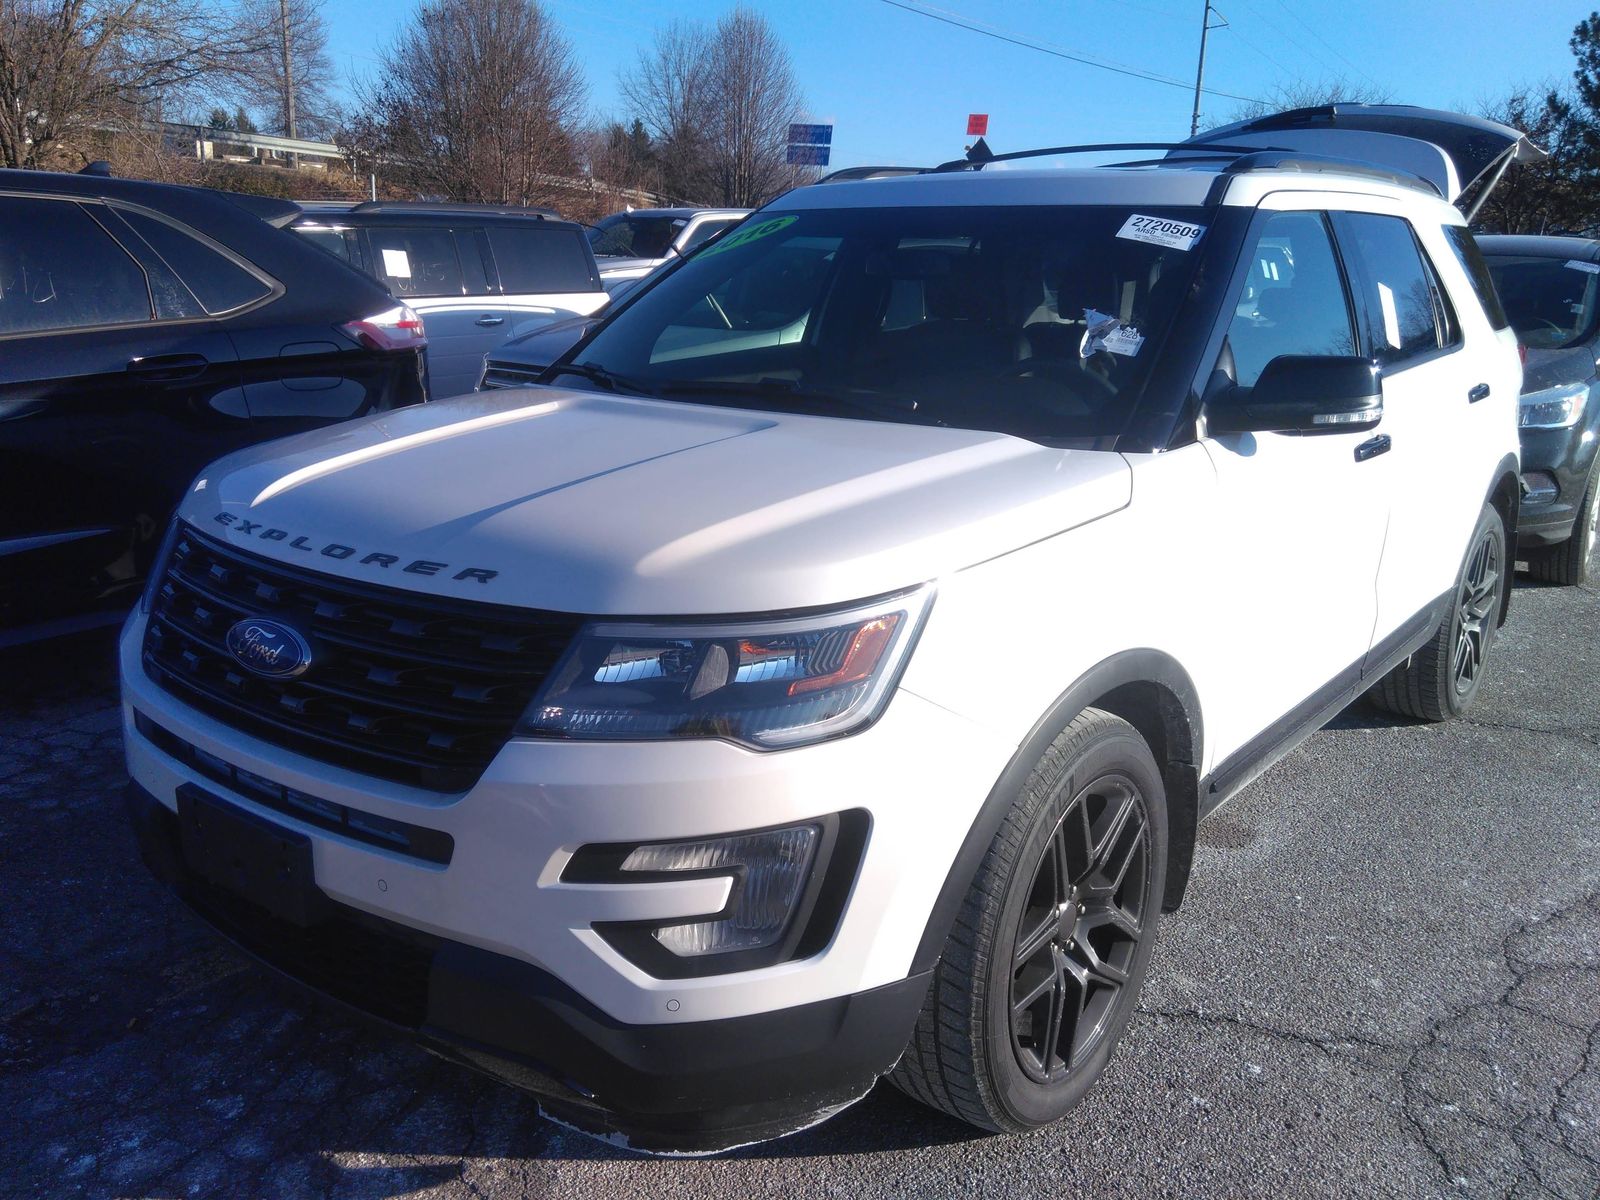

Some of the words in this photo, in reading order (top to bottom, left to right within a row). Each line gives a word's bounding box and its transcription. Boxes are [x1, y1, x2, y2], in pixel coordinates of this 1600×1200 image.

[1131, 216, 1201, 239] 2720509
[213, 511, 499, 584] EXPLORER
[238, 626, 285, 665] Ford
